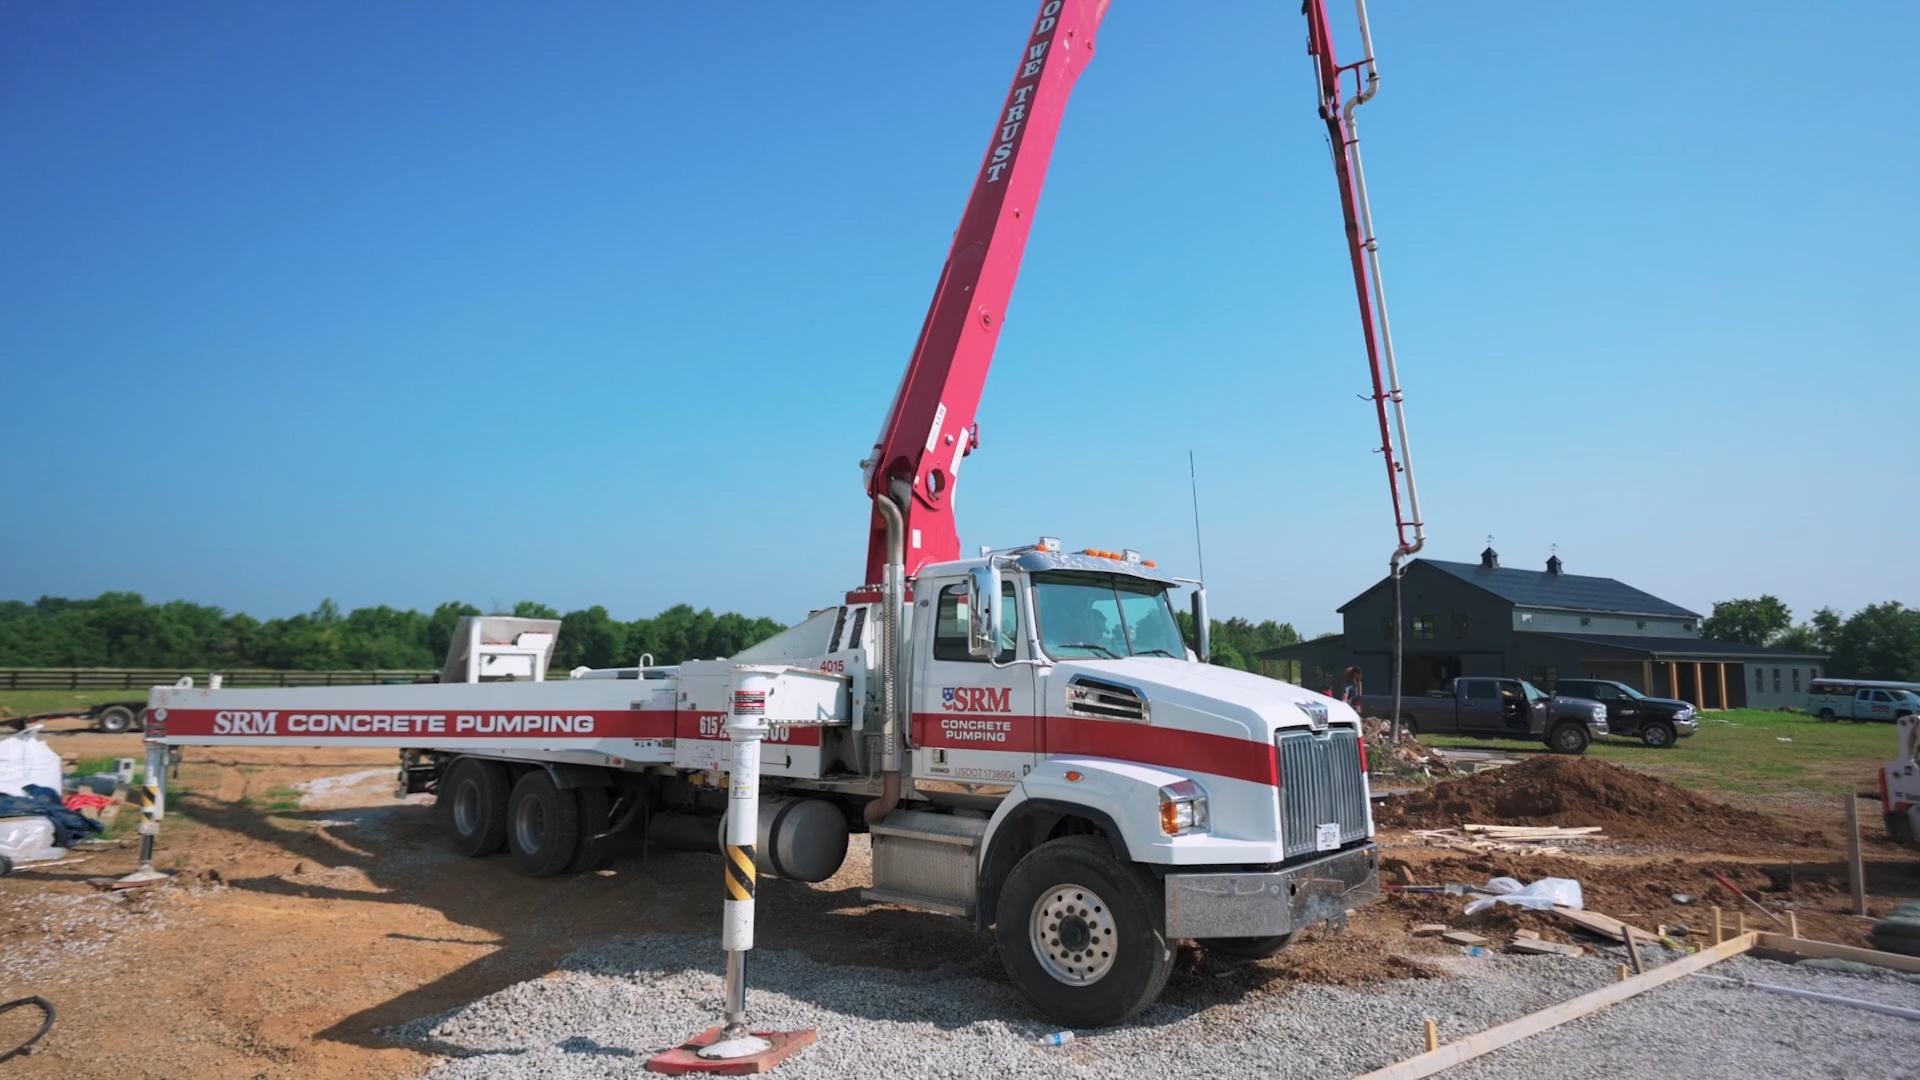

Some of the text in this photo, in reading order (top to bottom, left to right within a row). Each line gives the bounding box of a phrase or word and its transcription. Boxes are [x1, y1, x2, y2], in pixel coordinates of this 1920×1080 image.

[987, 0, 1061, 183] OD WE TRUST
[820, 660, 845, 672] 4015
[953, 687, 1012, 713] SRM
[213, 711, 595, 735] SRM CONCRETE PUMPING
[700, 716, 719, 735] 615
[941, 719, 1012, 731] CONCRETE
[946, 731, 1006, 742] PUMPING
